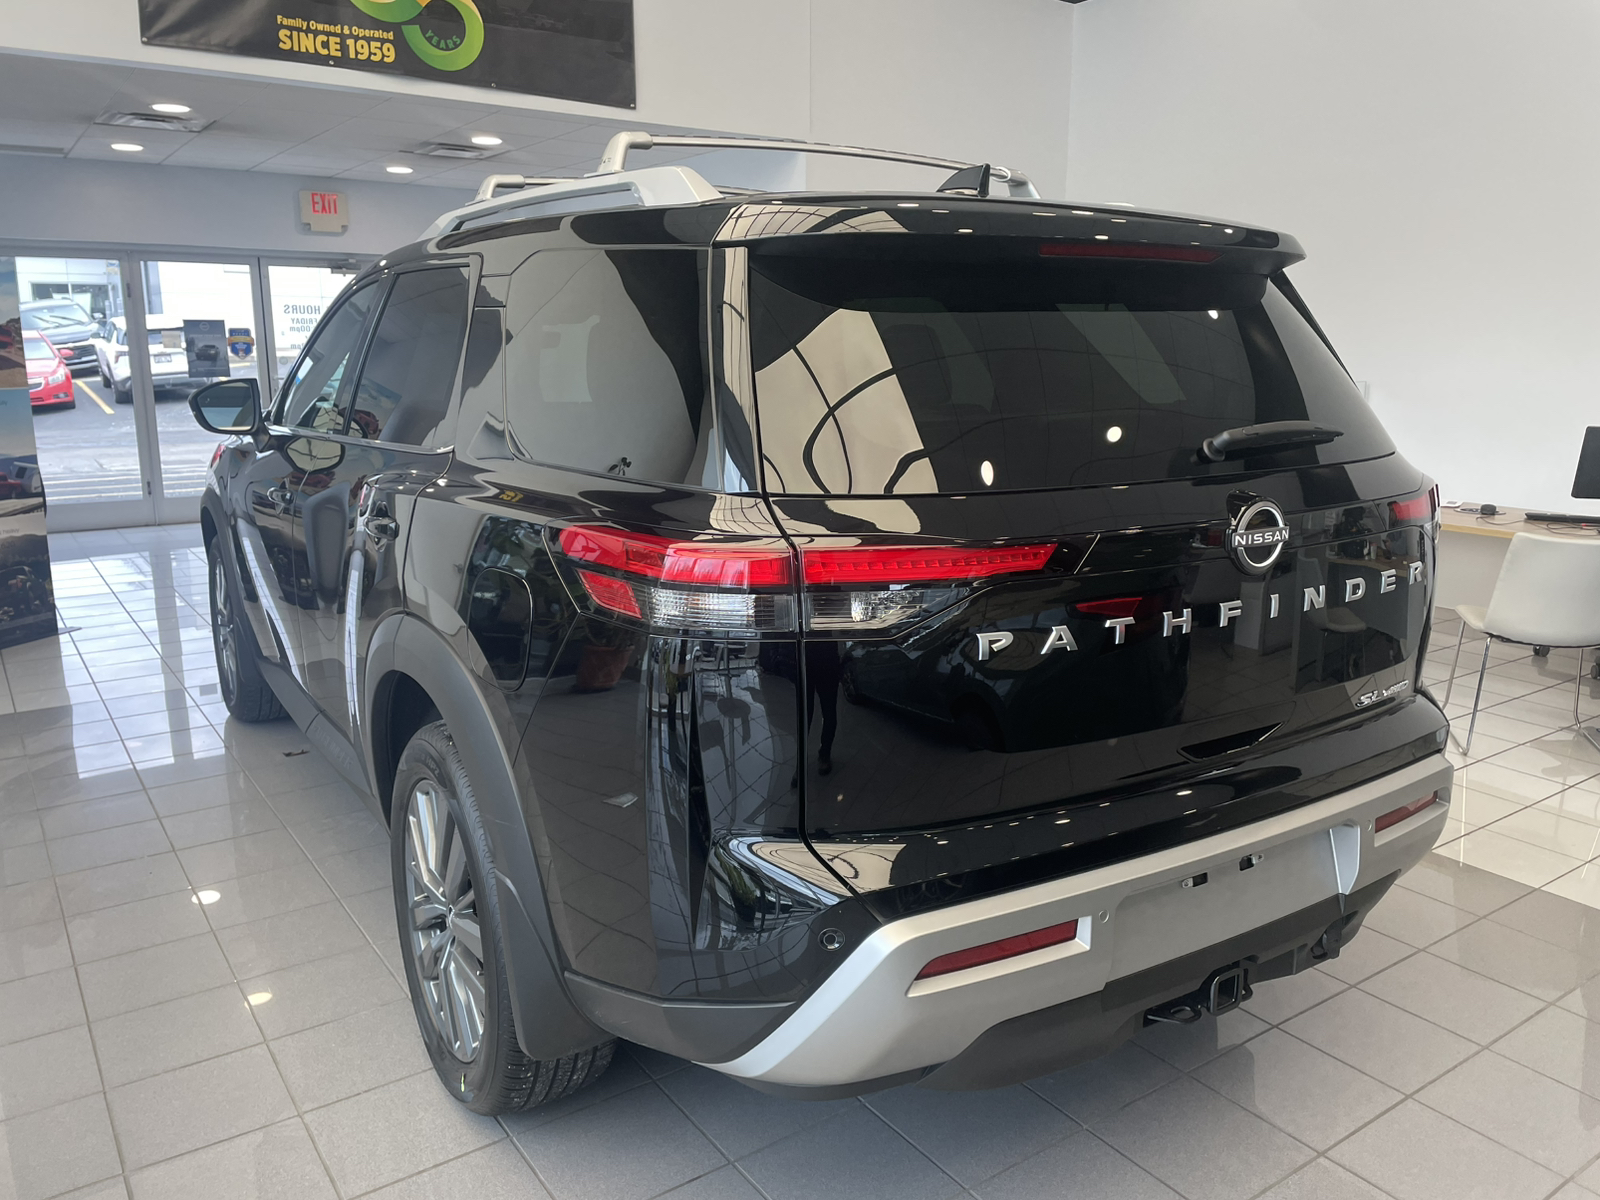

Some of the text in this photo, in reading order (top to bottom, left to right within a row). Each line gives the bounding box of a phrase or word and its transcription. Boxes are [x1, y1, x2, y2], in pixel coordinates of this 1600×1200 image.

[277, 15, 394, 40] Family Owned & Operated
[425, 29, 461, 49] YEARS
[278, 29, 396, 63] SINCE 1959
[311, 192, 338, 215] EXIT
[1234, 527, 1290, 547] NISSAN
[976, 560, 1424, 661] PATHFINDER
[1355, 690, 1381, 707] SL
